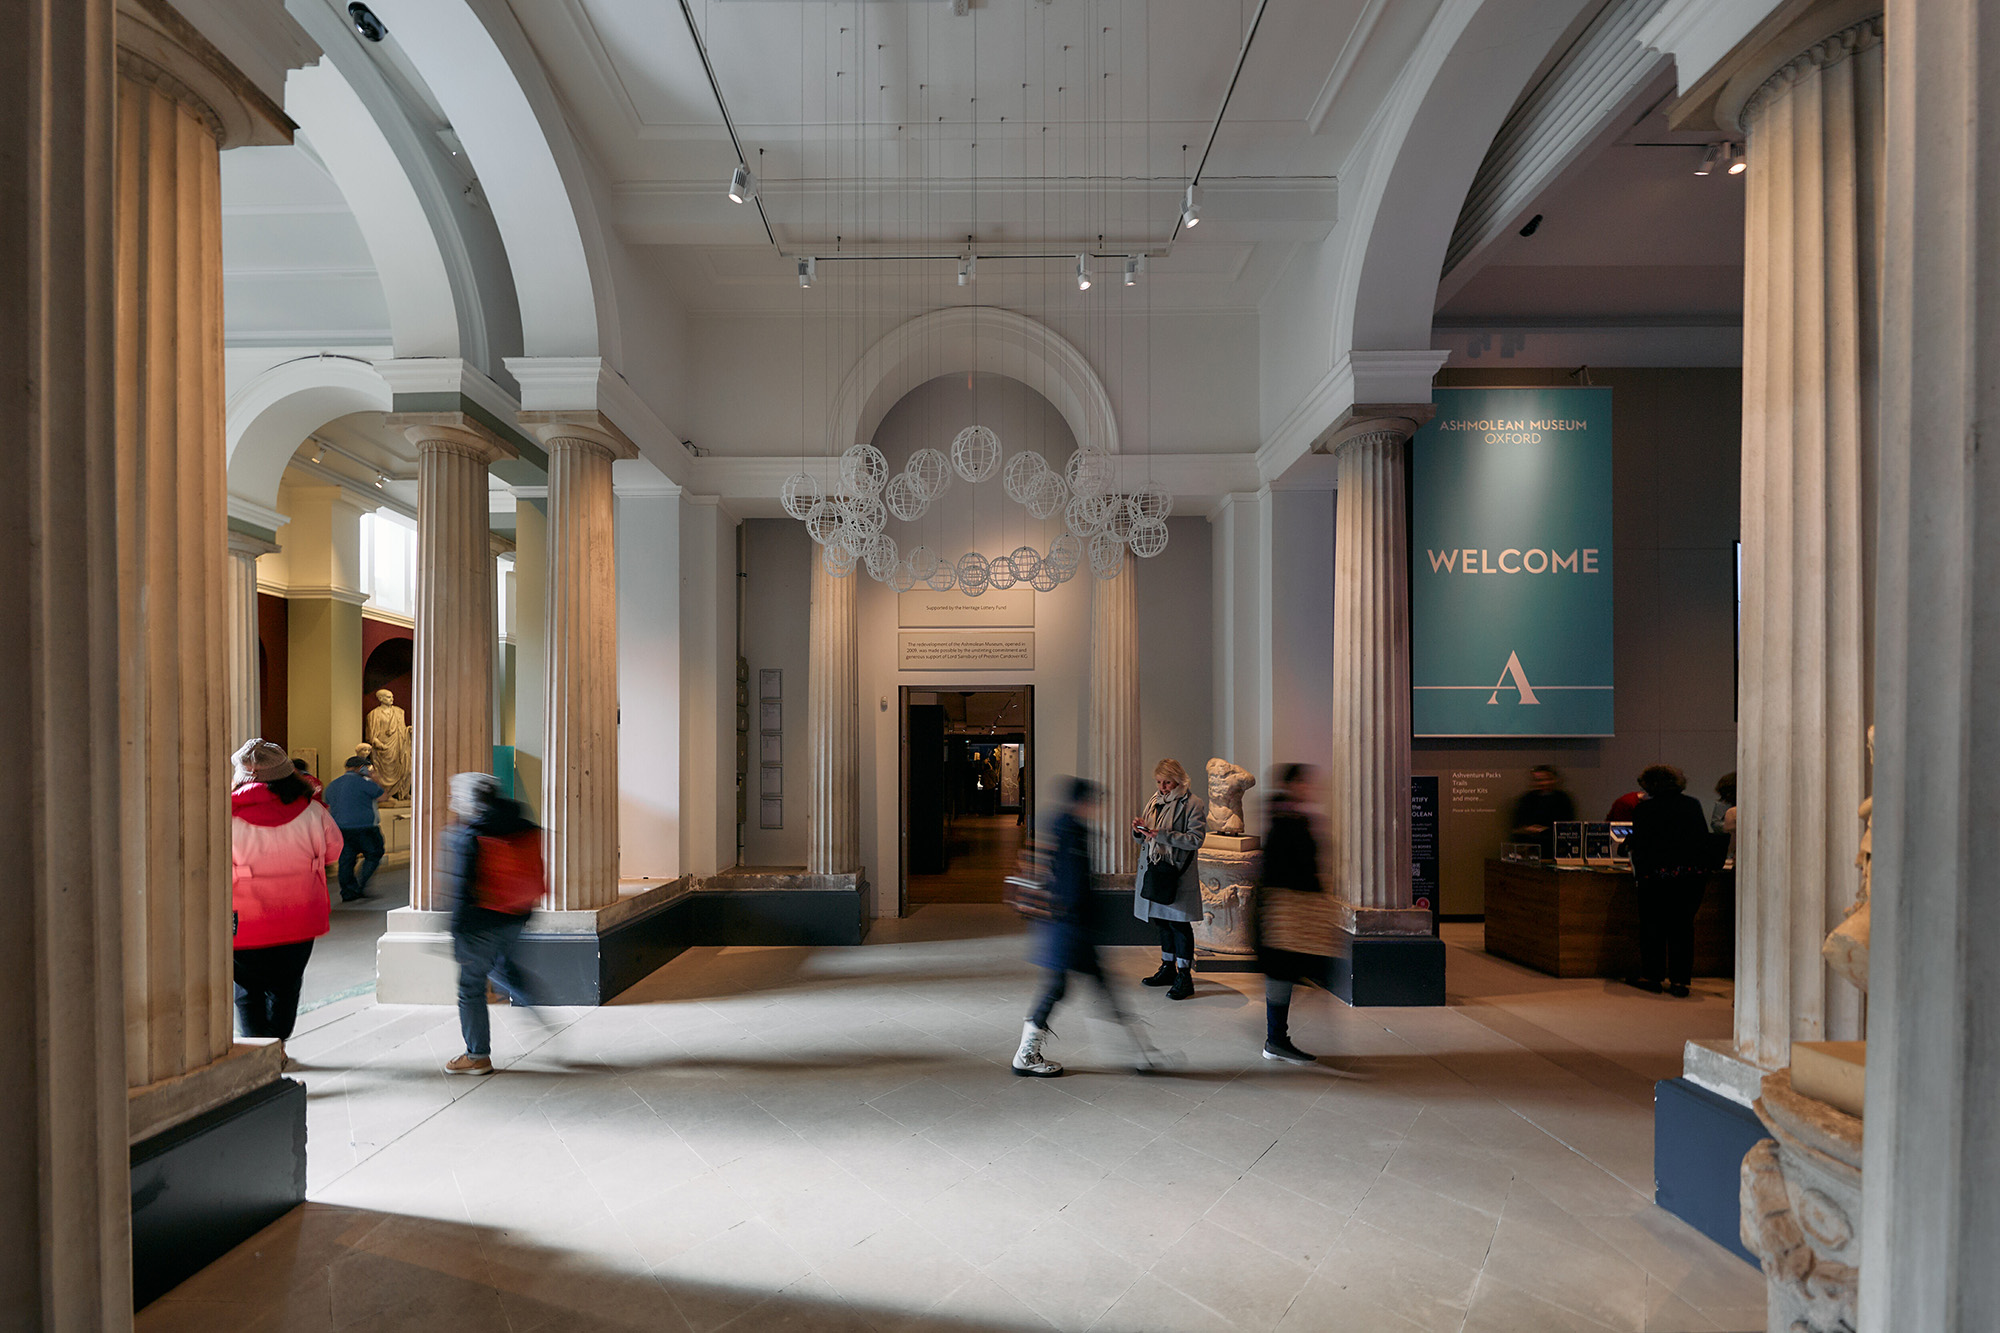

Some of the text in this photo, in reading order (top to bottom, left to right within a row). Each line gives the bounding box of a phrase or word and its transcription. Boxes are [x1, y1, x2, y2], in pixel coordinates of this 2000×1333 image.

[1440, 420, 1587, 431] ASHMOLEAN MUSEUM
[1484, 433, 1542, 444] OXFORD
[1427, 549, 1599, 574] WELCOME
[1487, 650, 1540, 704] A
